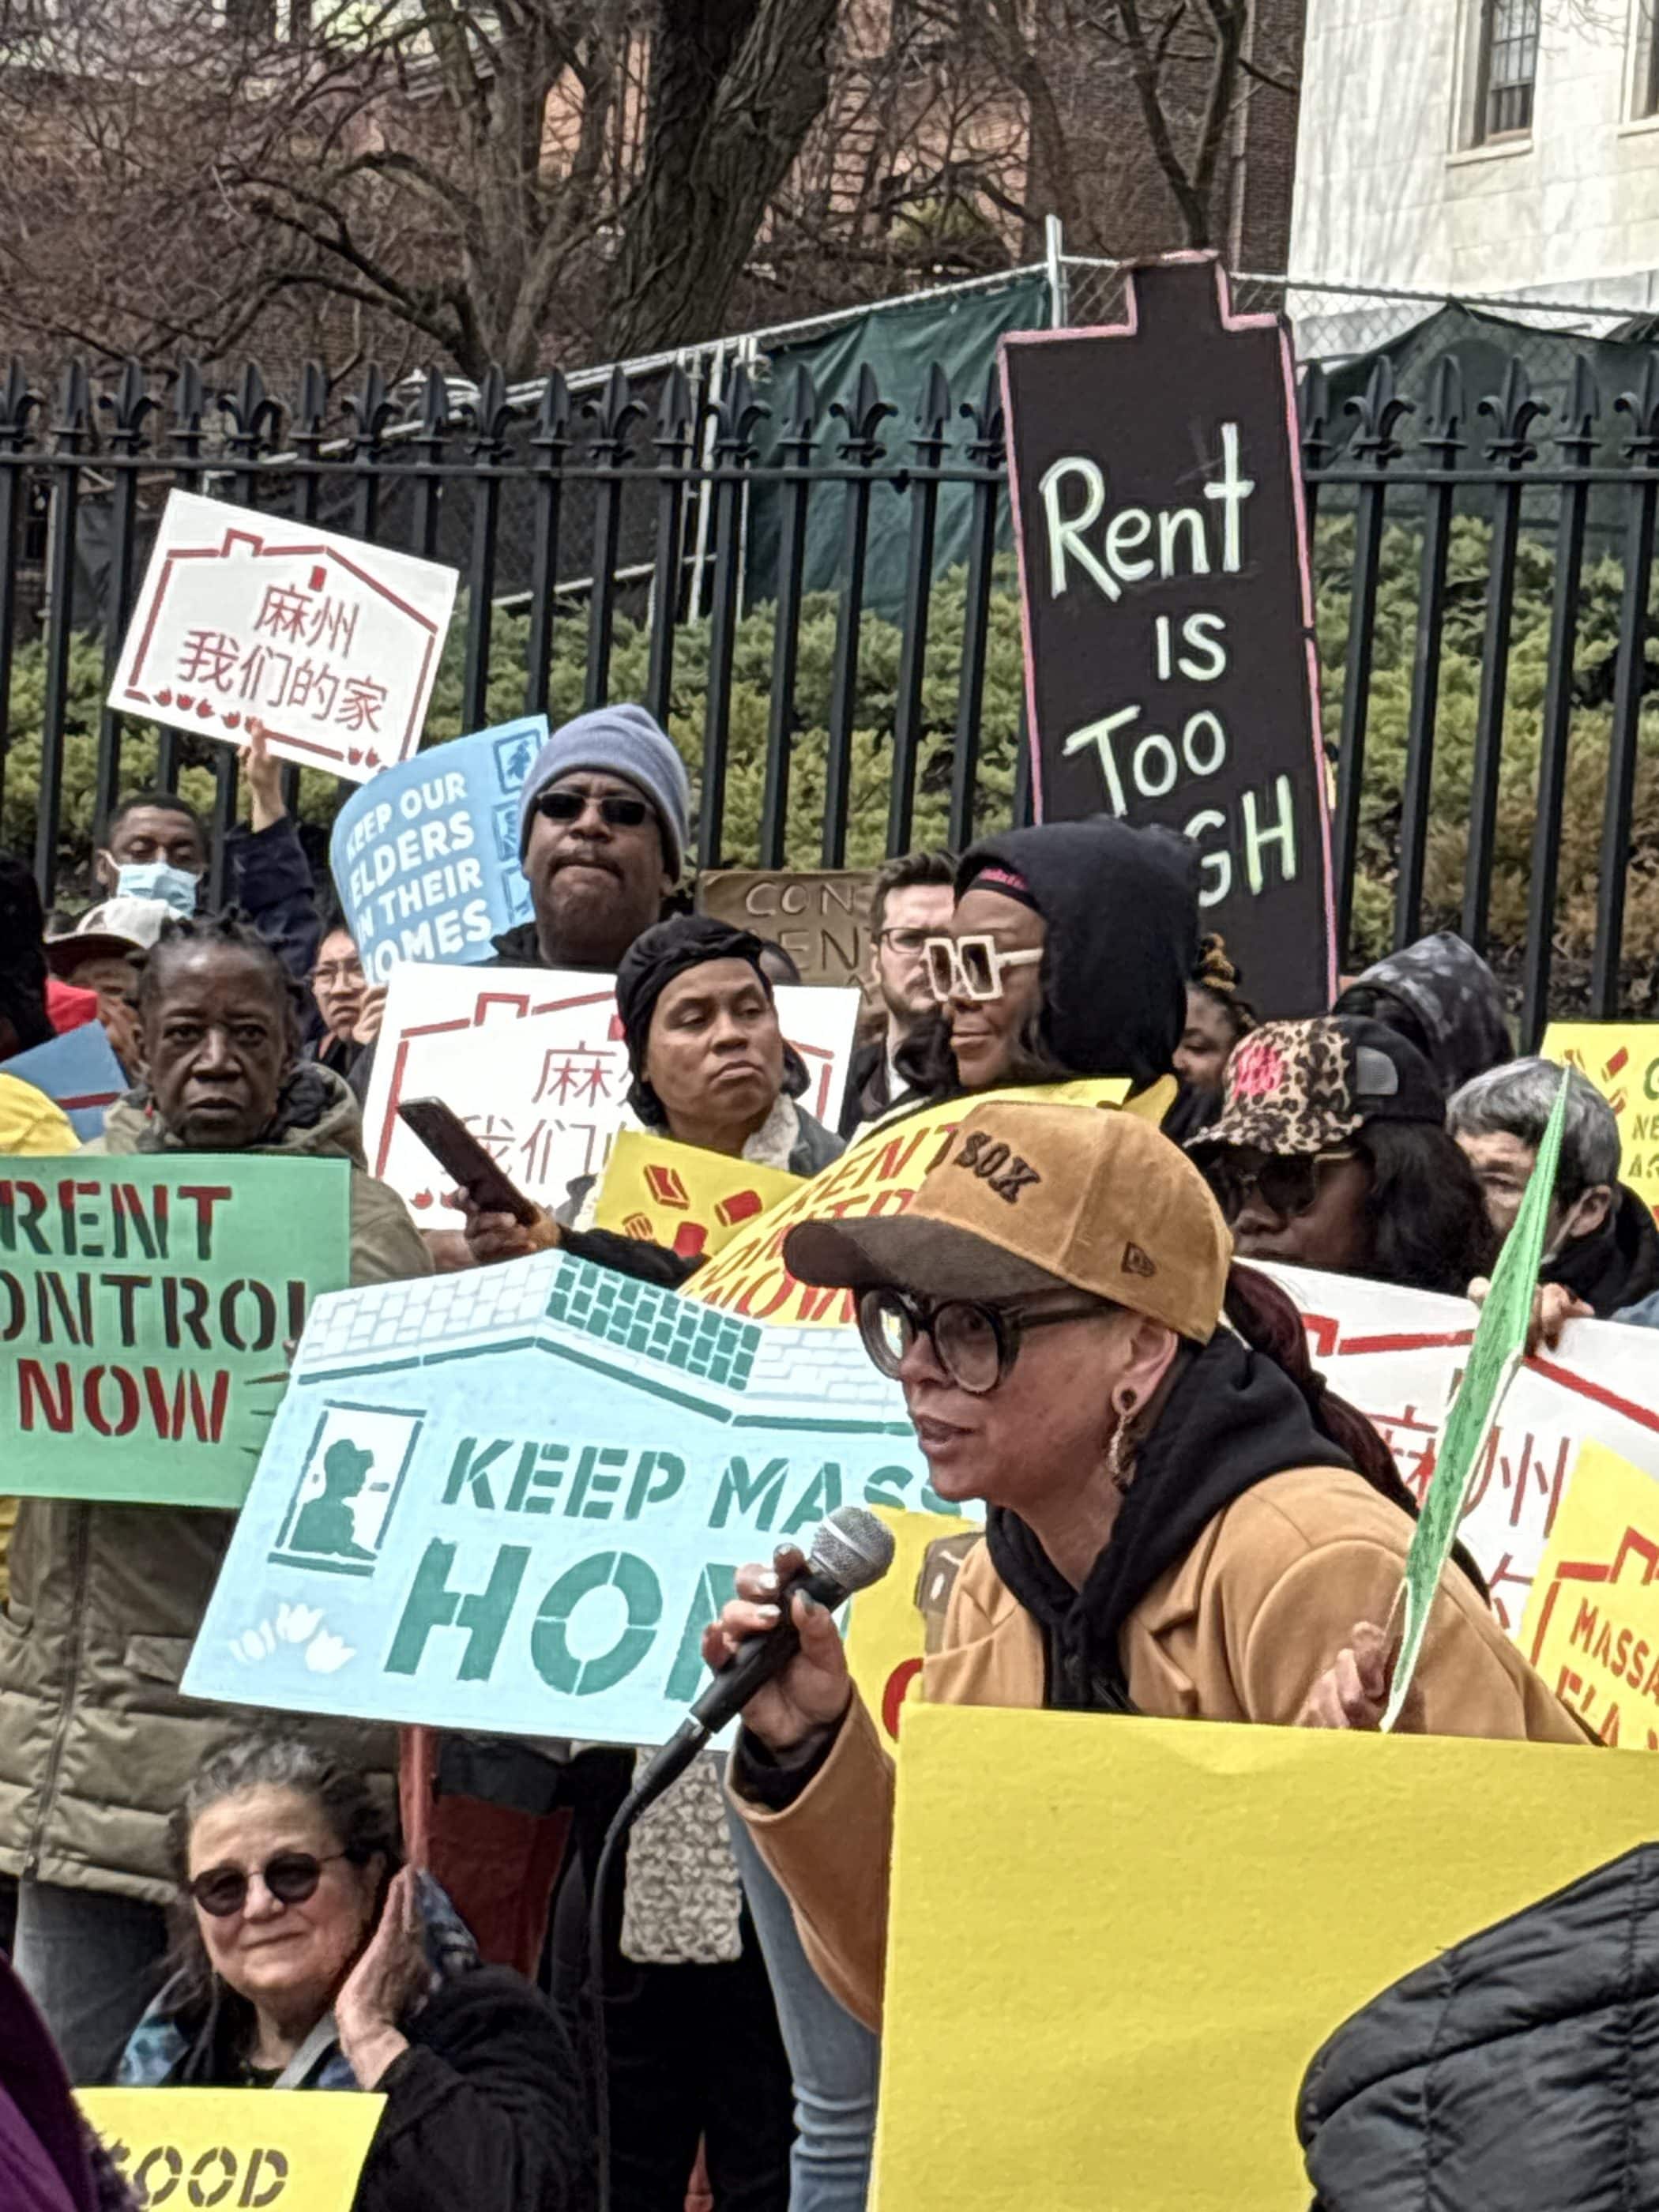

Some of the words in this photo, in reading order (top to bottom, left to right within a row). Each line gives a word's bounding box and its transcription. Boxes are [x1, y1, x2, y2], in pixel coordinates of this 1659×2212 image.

[1039, 423, 1255, 602] Rent
[254, 584, 359, 659] 麻州
[178, 630, 387, 732] 我们的家
[346, 803, 393, 863] KEEP
[400, 772, 468, 819] OUR
[349, 811, 474, 909] ELDERS
[1183, 775, 1296, 907] GH
[378, 858, 483, 924] THEIR
[532, 1040, 630, 1108] 麻
[953, 1130, 1041, 1204] SOX
[0, 1179, 232, 1260] RENT
[17, 1358, 229, 1443] NOW
[442, 1435, 685, 1521] KEEP
[384, 1537, 790, 1702] HO
